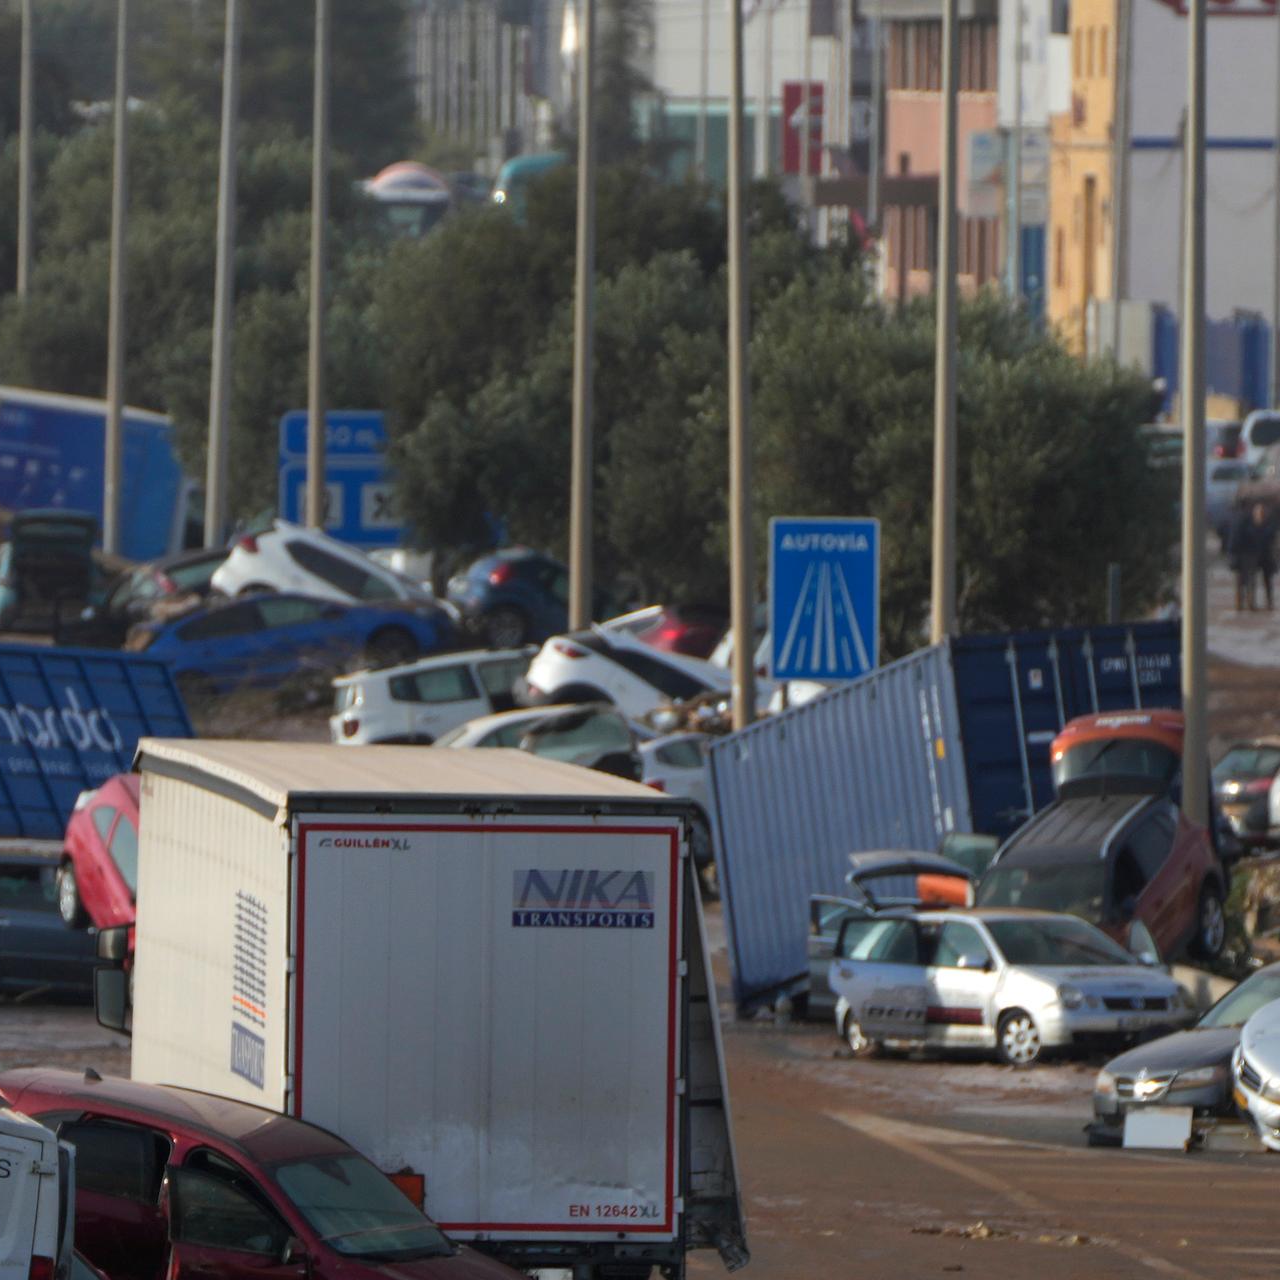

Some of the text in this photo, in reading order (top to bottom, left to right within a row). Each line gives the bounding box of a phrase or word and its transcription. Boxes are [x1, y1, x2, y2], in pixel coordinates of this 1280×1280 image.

[780, 531, 869, 552] AUTOVÍA
[517, 868, 655, 909] NIKA
[518, 912, 653, 929] TRANSPORTS
[569, 1205, 590, 1217] EN
